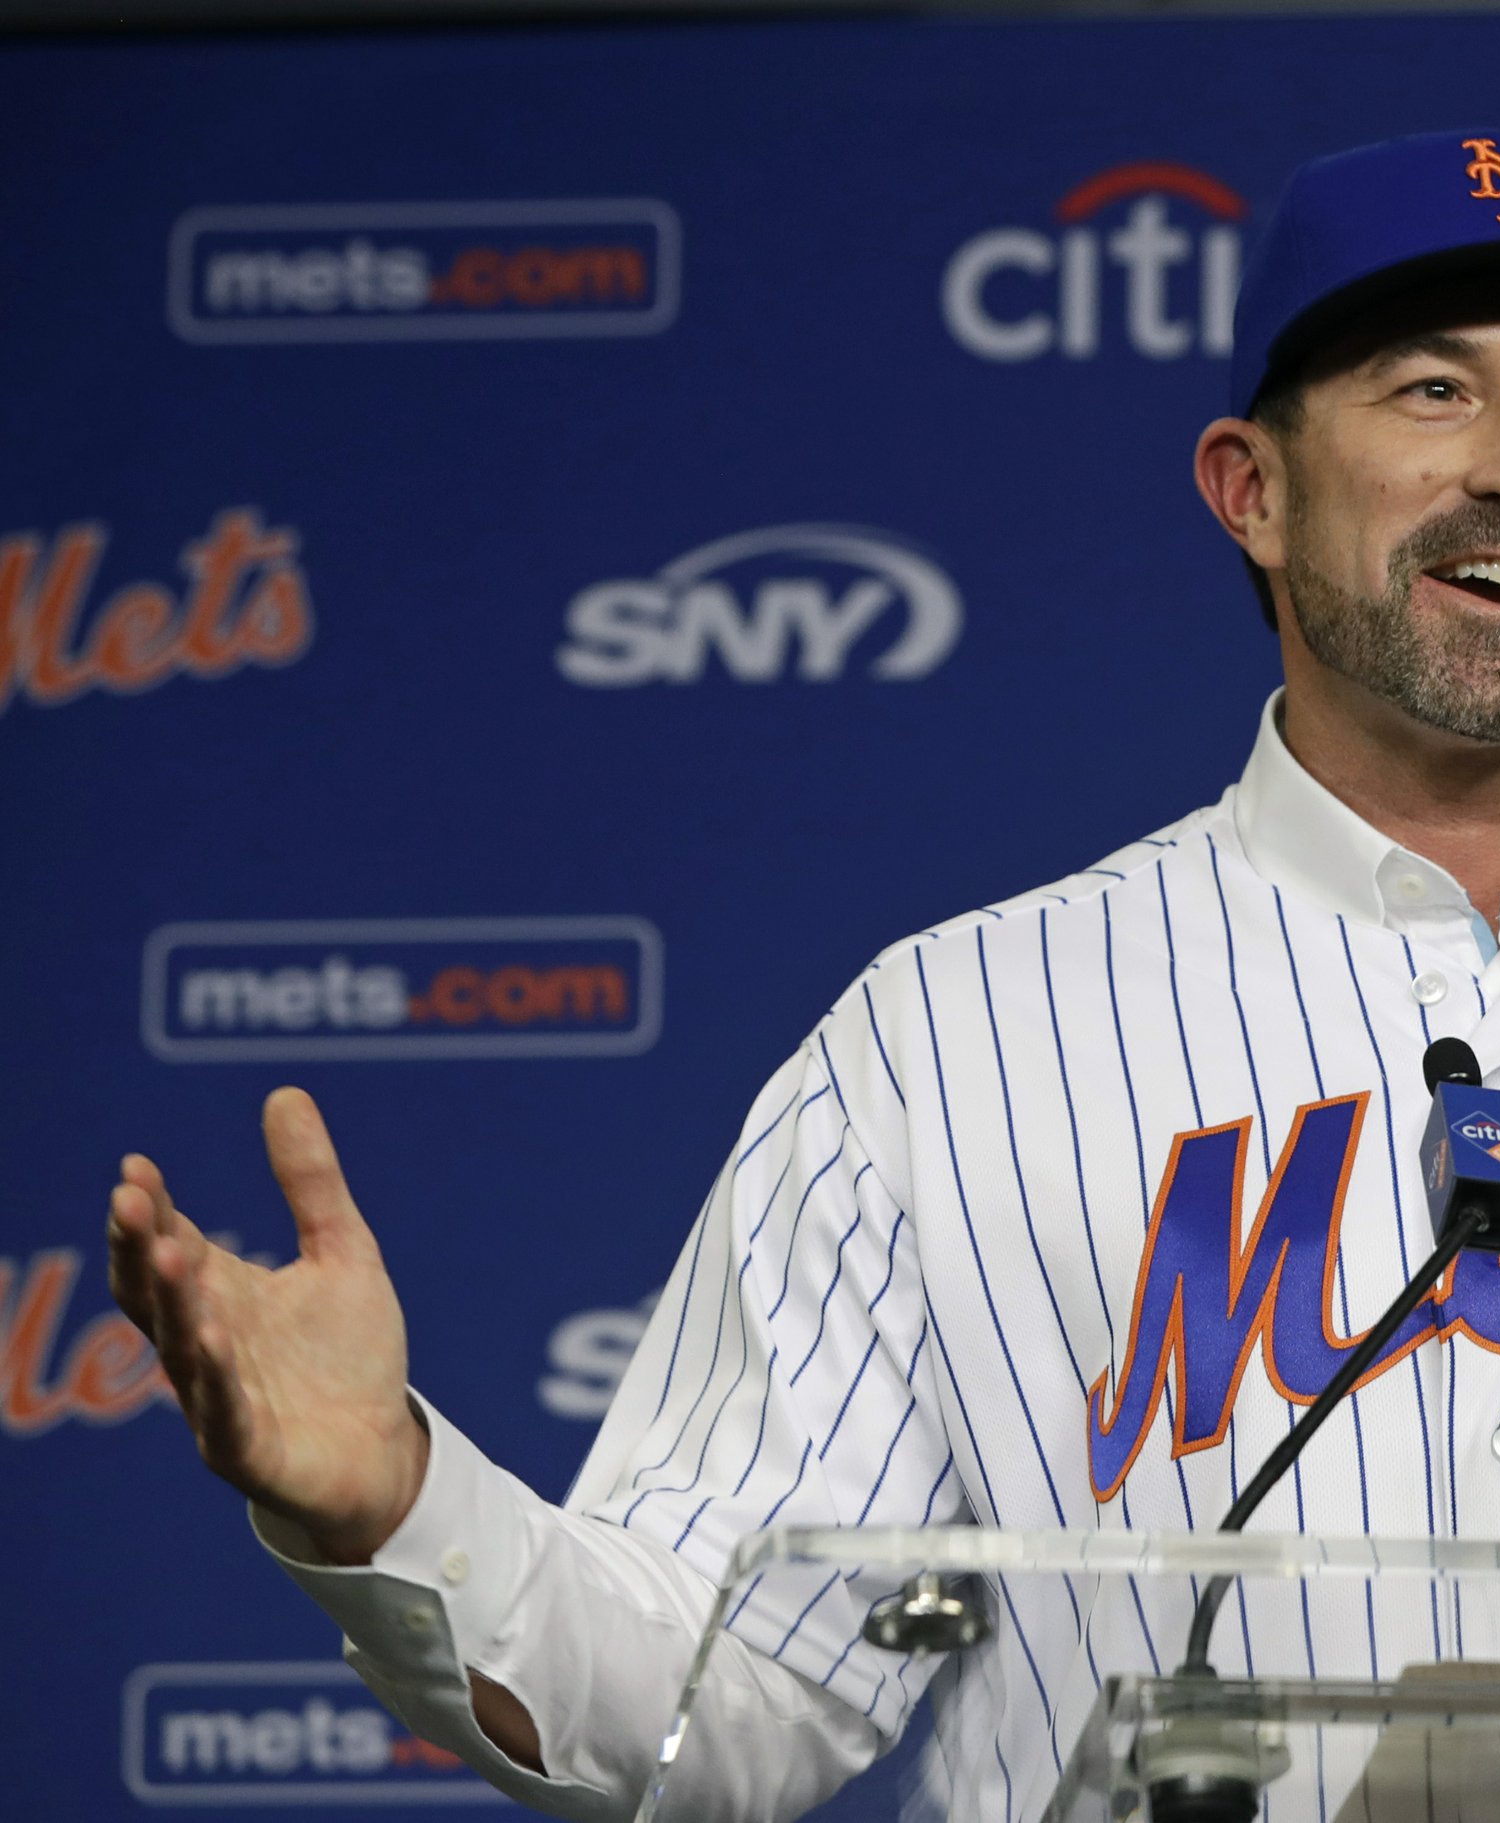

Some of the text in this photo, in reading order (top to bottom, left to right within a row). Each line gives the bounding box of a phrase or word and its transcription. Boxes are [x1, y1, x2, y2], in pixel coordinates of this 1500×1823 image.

[207, 241, 647, 311] mets.com
[943, 195, 1234, 361] citi
[557, 580, 888, 687] SNY
[181, 956, 628, 1029] mets.com
